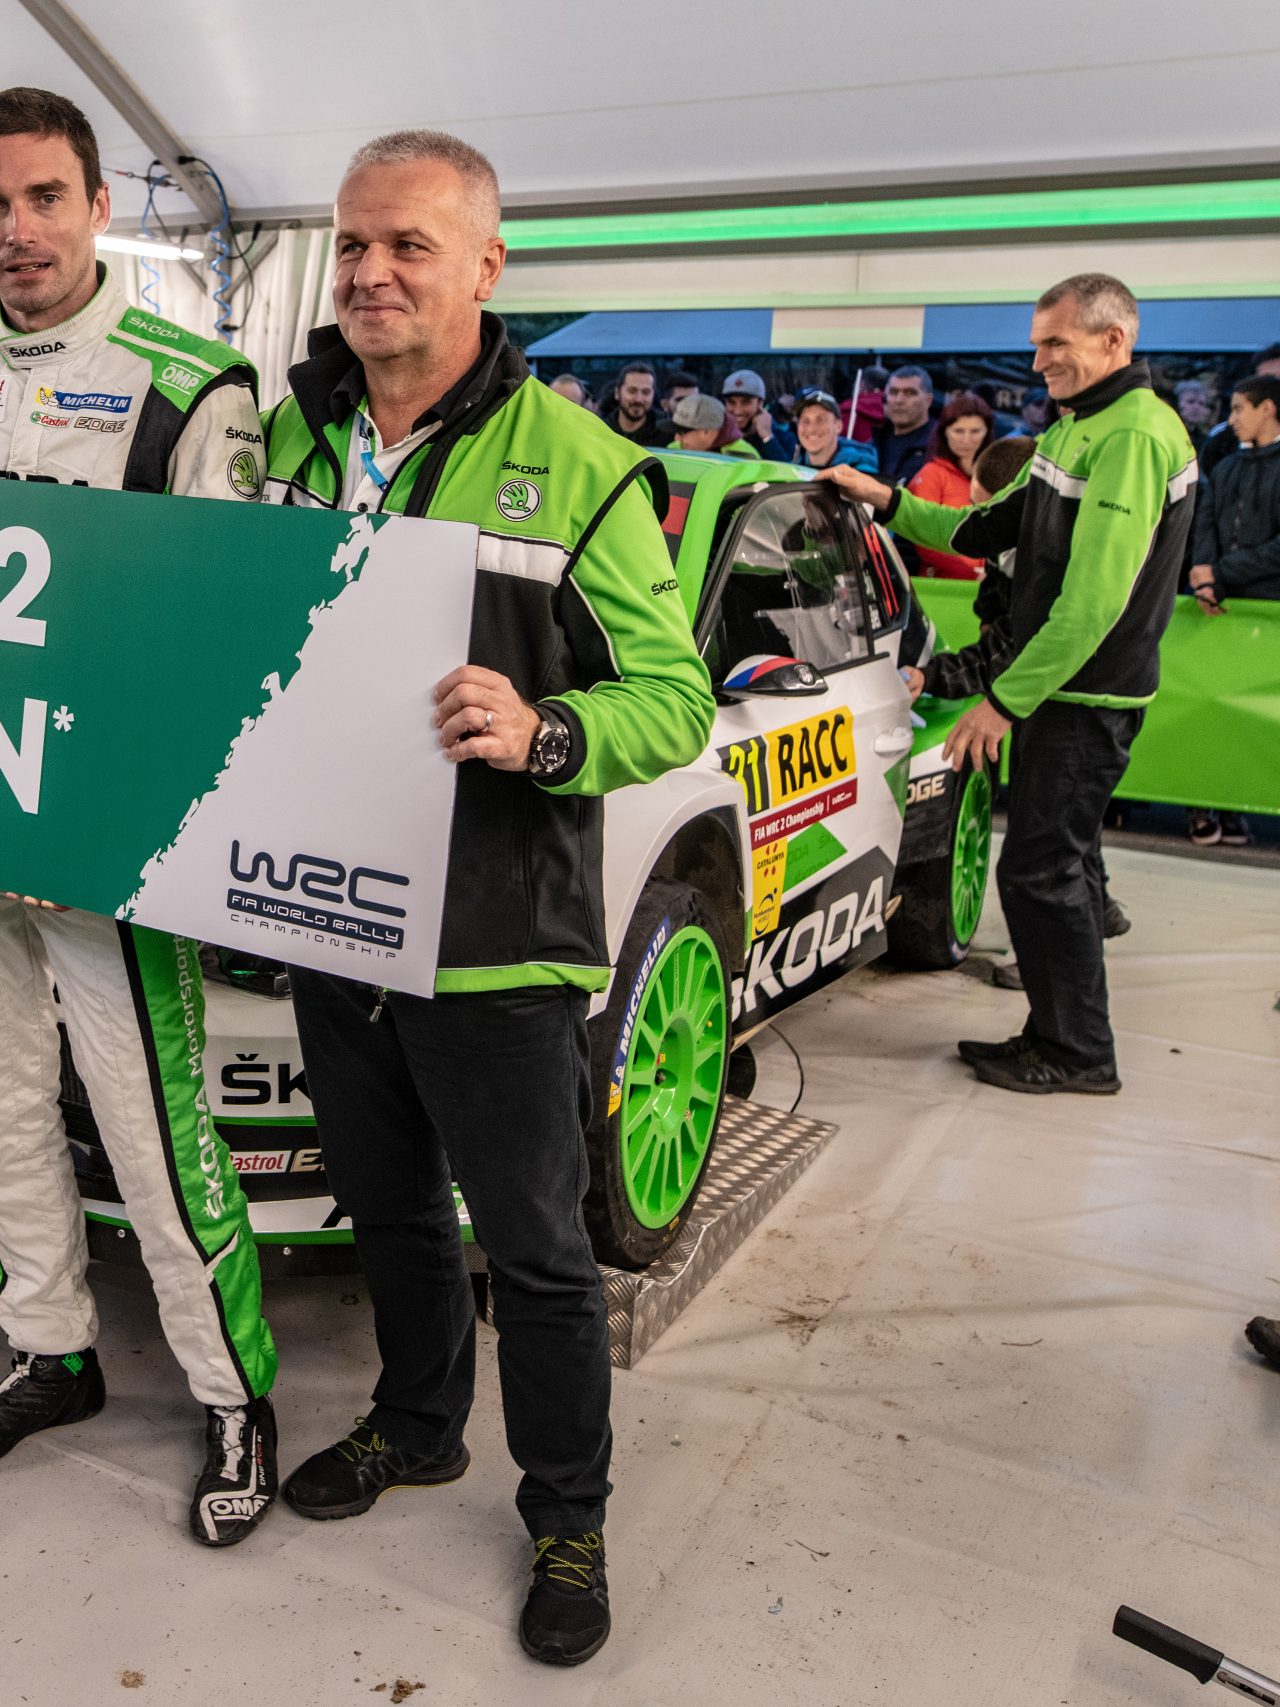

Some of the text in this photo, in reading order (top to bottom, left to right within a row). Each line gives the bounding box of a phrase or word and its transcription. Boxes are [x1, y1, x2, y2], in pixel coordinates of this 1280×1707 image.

[9, 341, 66, 357] ŠKODA
[161, 366, 199, 390] OMP
[62, 396, 129, 408] MICHELIN
[40, 415, 127, 432] Castrol EDGE
[226, 426, 263, 445] ŠKODA
[501, 459, 550, 475] ŠKODA
[777, 713, 848, 797] RACC
[906, 773, 946, 807] DGE
[754, 801, 825, 842] FIA WRC 2 Championship
[756, 851, 785, 870] CATALUNYA
[230, 840, 410, 918] WRC
[230, 913, 397, 959] CHAMPIONSHIP
[231, 895, 399, 943] FIA WORLD RALLY
[172, 935, 204, 1079] Motorsport
[619, 925, 666, 1057] MICHELIN
[221, 1053, 314, 1106] ŠK
[65, 1353, 84, 1372] OMP
